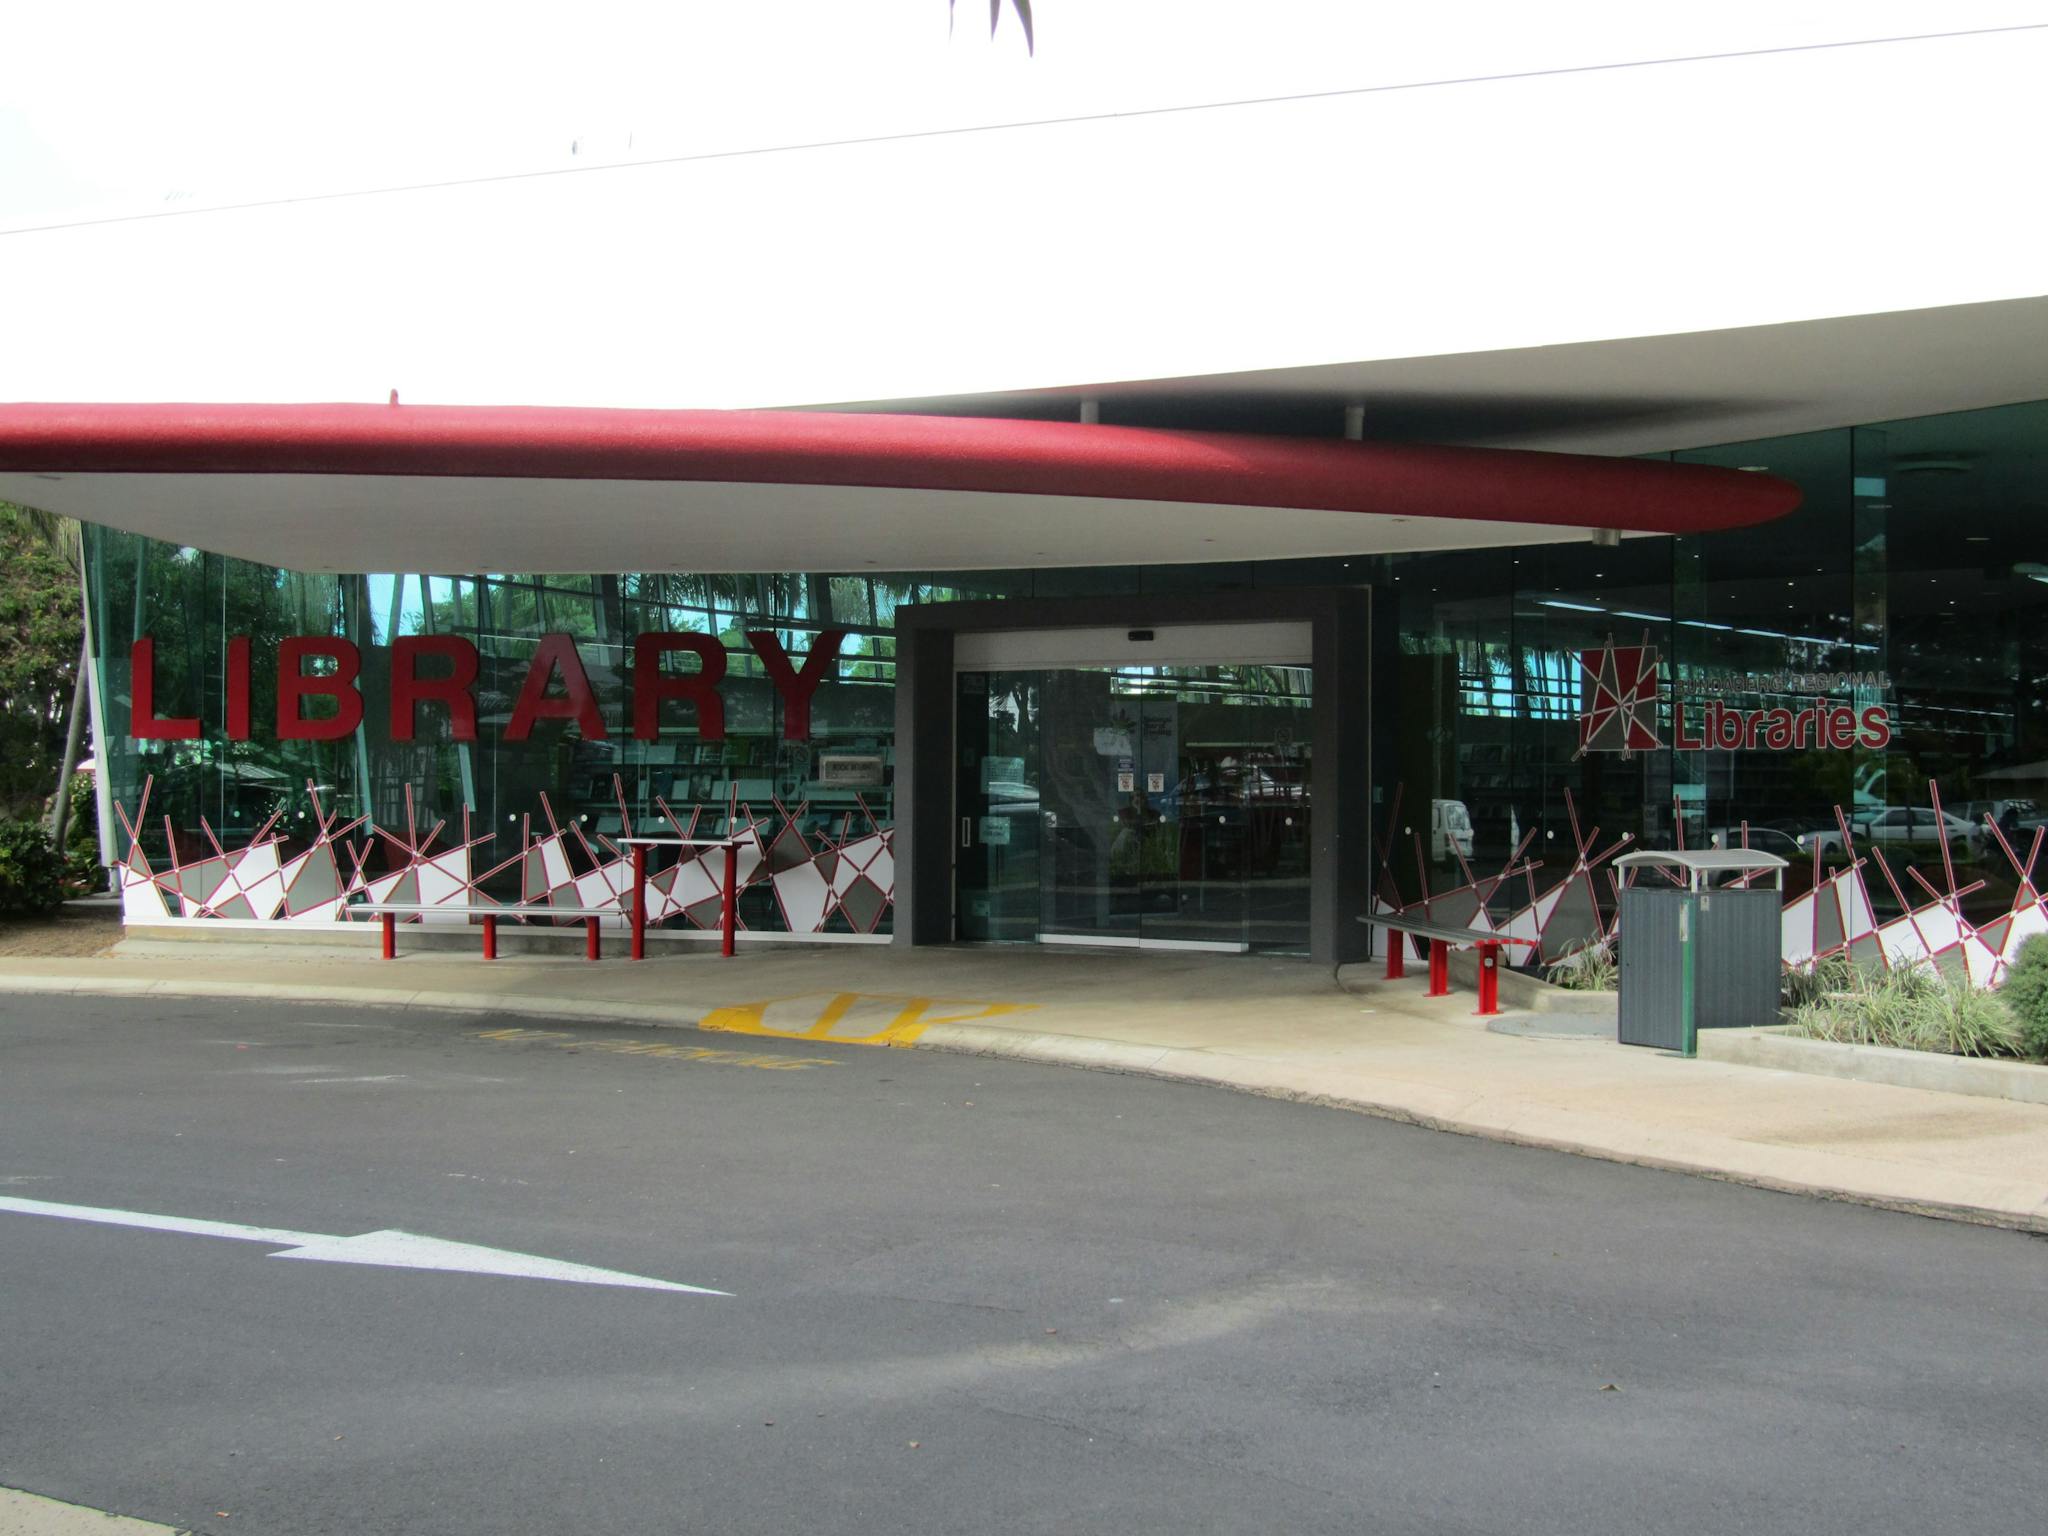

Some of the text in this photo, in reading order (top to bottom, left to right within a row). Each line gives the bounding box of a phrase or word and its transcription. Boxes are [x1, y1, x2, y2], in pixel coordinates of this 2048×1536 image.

[131, 630, 846, 742] LIBRARY
[1674, 671, 1892, 696] BUNDABERG REGIONAL
[1674, 697, 1890, 750] Libraries
